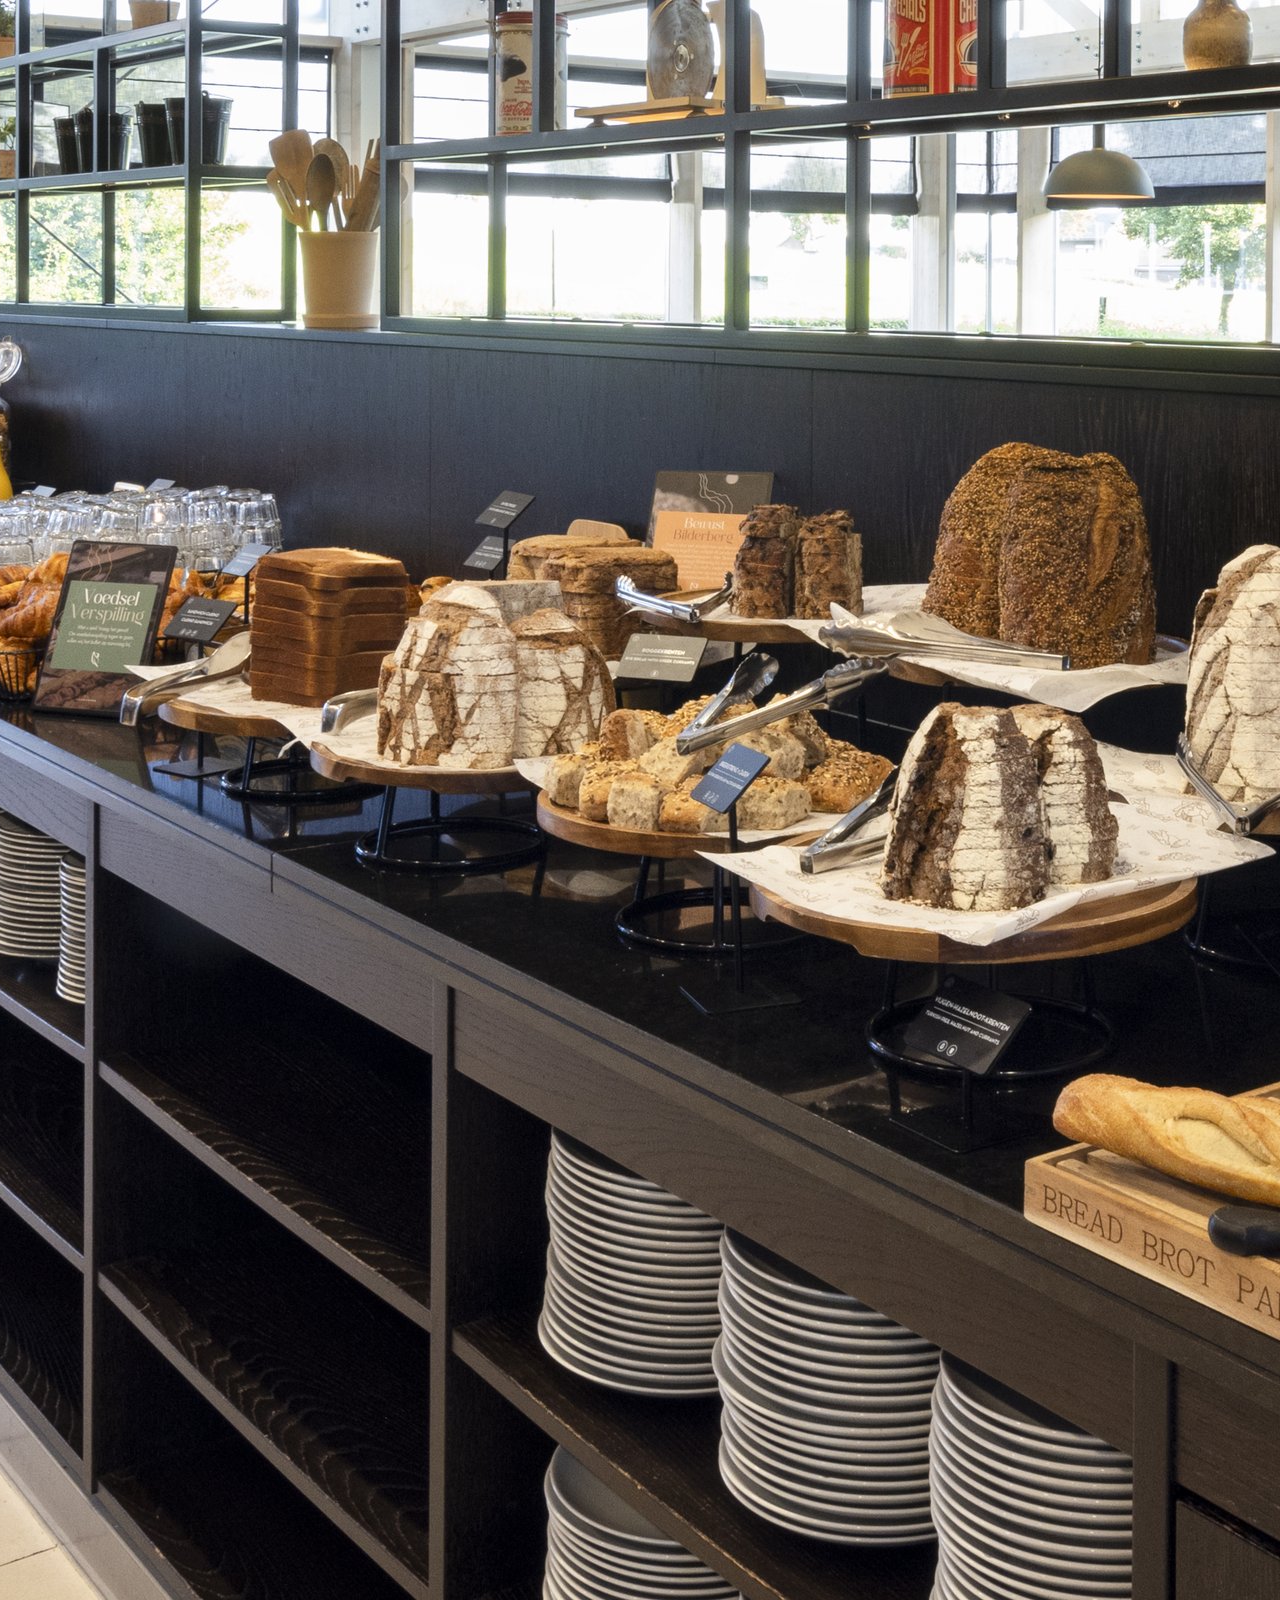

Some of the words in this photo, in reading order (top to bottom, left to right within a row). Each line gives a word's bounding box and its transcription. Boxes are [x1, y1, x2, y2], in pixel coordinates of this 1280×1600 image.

[673, 528, 734, 544] Bilderberg
[85, 588, 140, 607] Voedsel
[71, 603, 145, 626] Verspilling
[1042, 1183, 1124, 1245] BREAD
[1141, 1229, 1216, 1288] BROT
